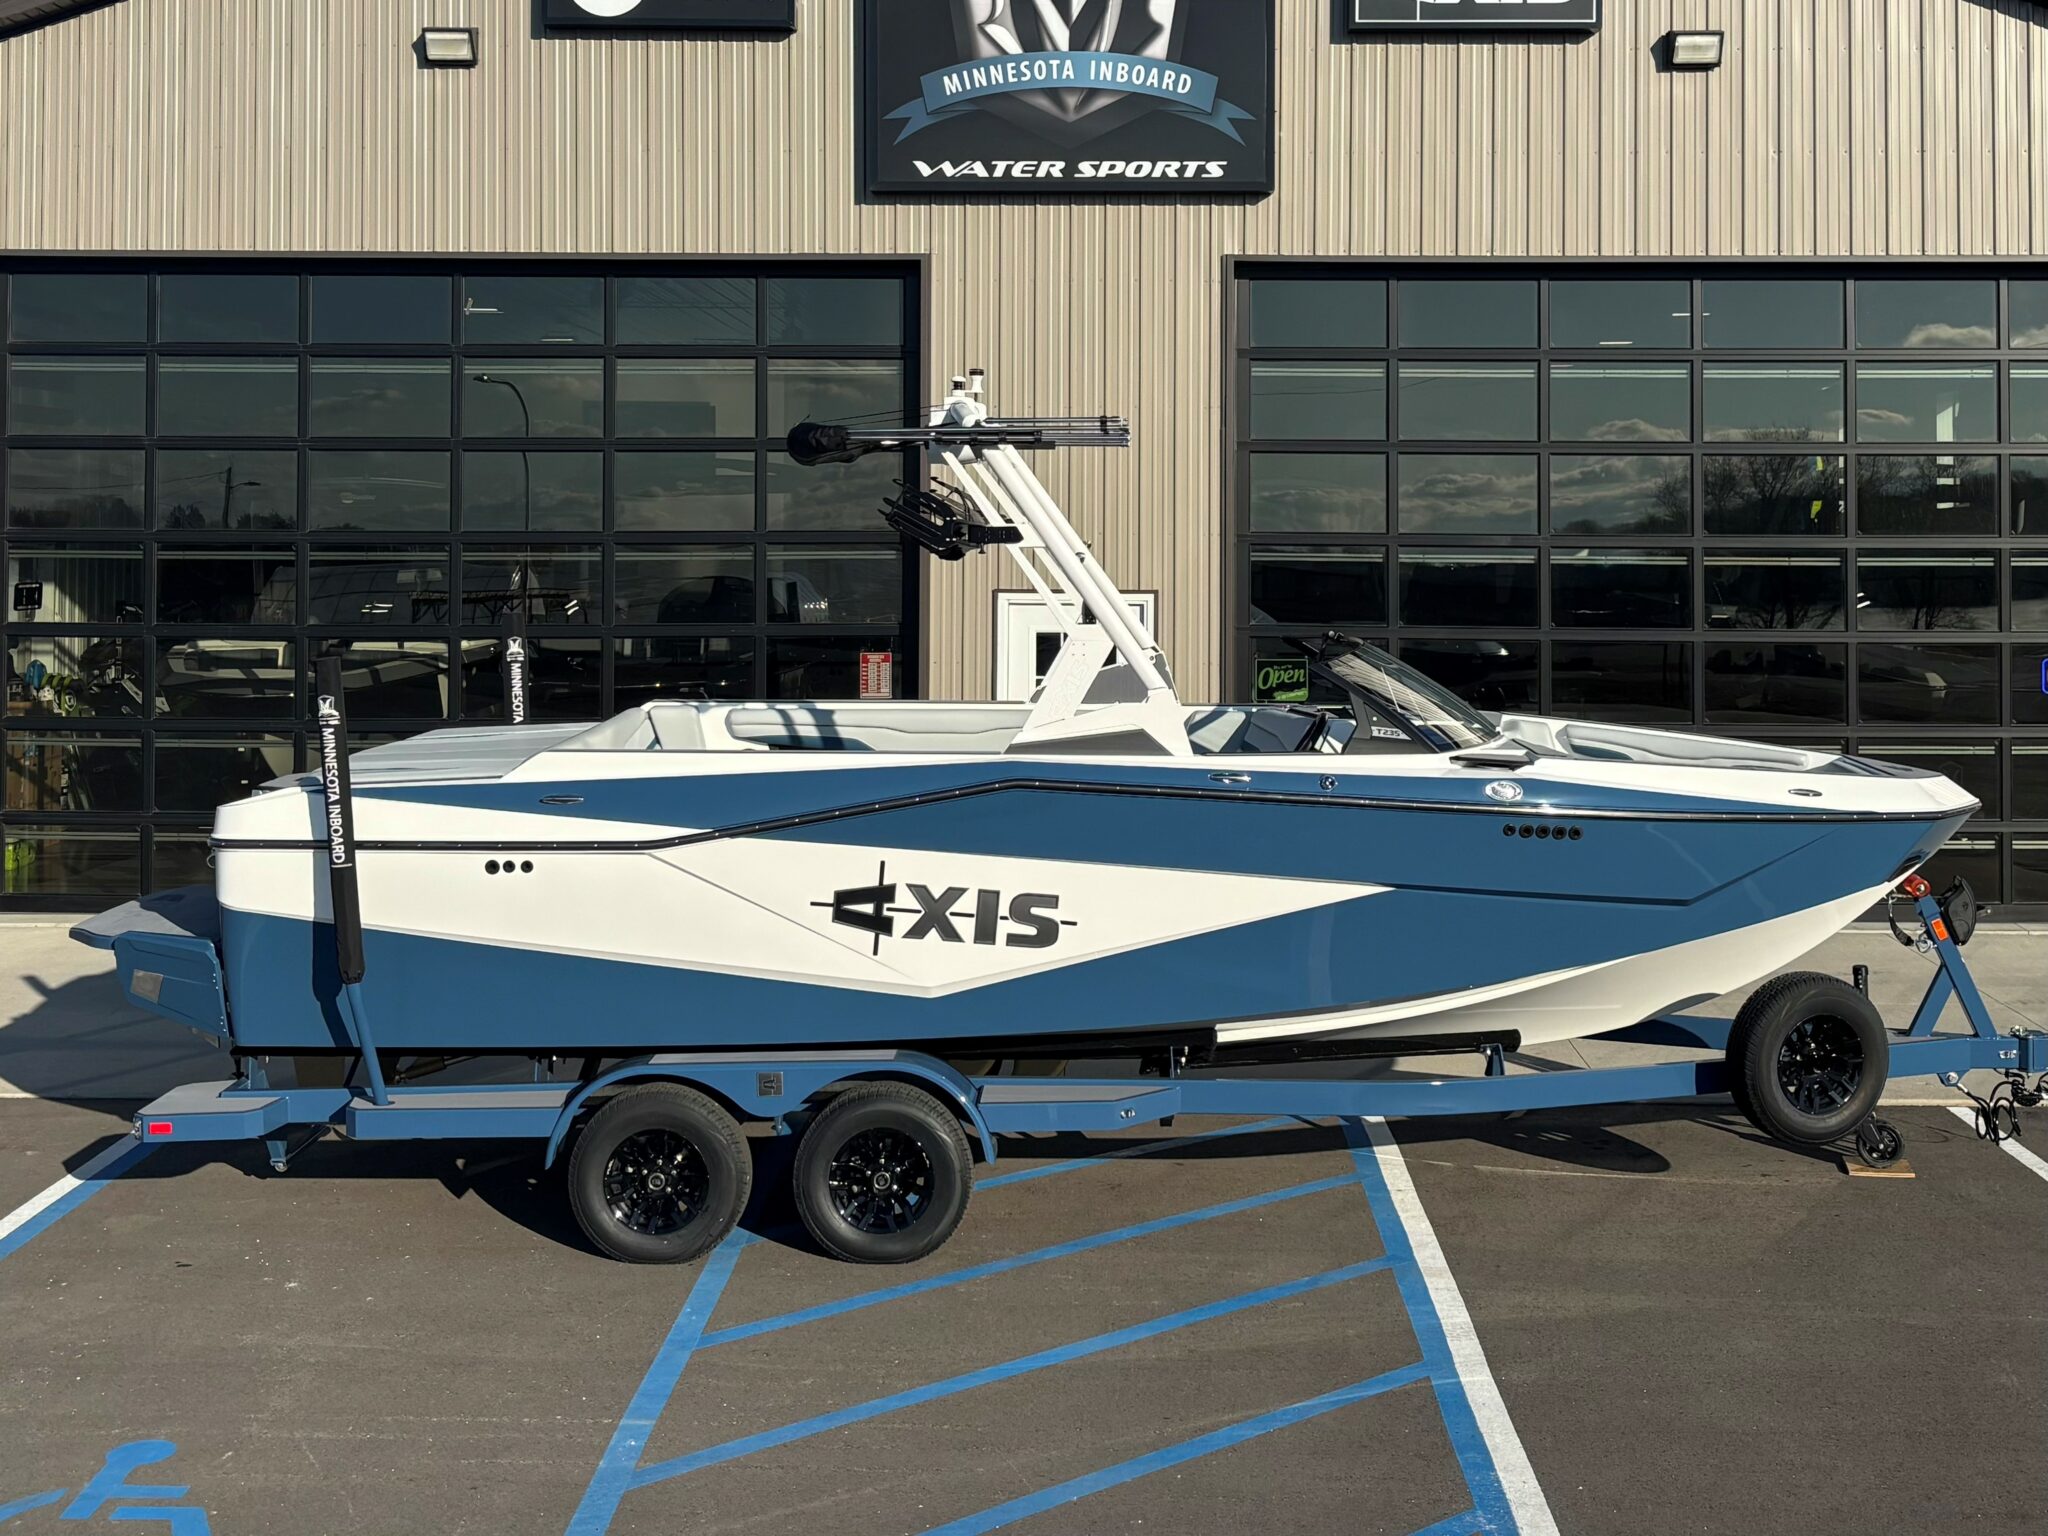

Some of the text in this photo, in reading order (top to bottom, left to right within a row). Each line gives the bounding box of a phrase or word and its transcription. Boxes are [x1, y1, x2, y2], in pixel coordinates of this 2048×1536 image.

[942, 59, 1193, 96] MINNESOTA INBOARD
[912, 160, 1228, 178] WATER SPORTS
[510, 662, 524, 724] MINNESOTA
[1258, 667, 1306, 689] Open
[1376, 728, 1401, 737] T235
[321, 727, 346, 864] MINNESOTA INBOARD
[832, 882, 1060, 949] AXIS
